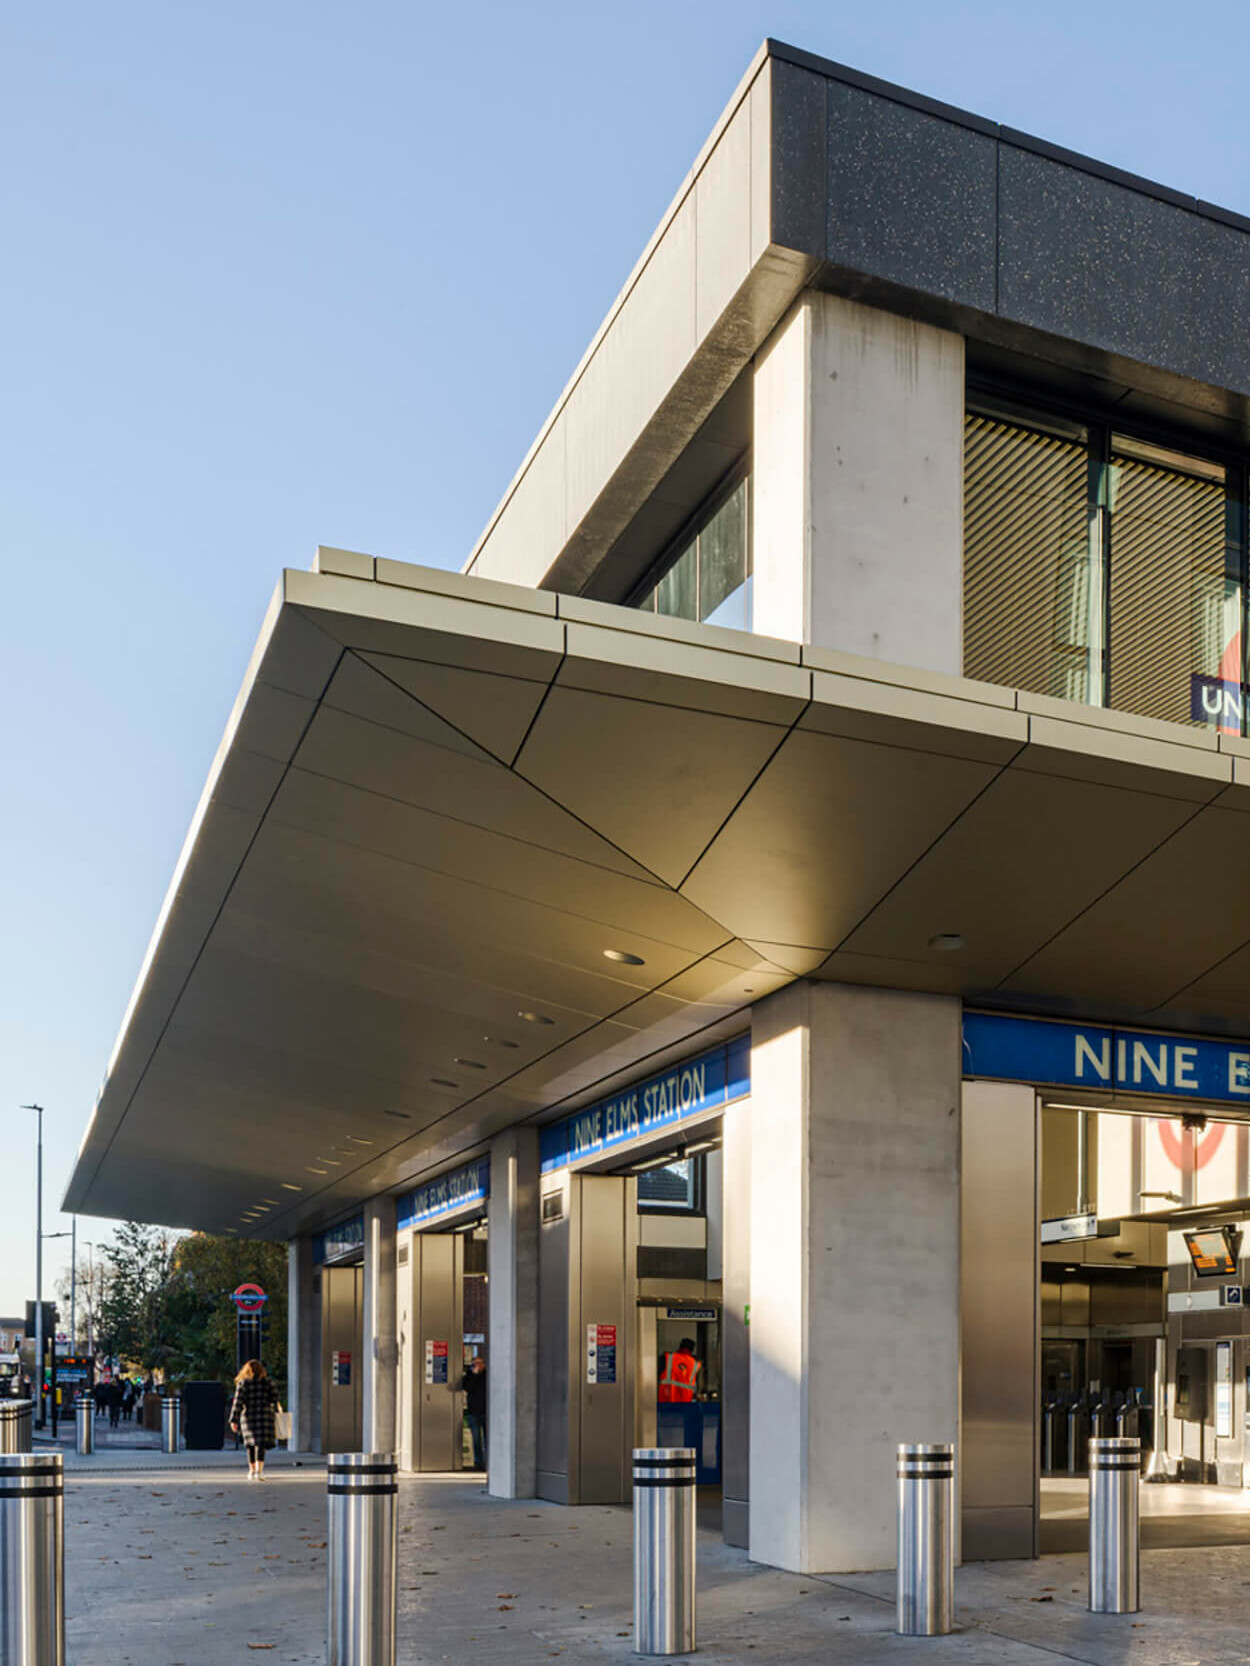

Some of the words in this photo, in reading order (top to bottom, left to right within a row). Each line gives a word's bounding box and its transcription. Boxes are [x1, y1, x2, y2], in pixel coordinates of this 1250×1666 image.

[1075, 1034, 1199, 1088] NINE
[575, 1110, 602, 1154] NINE
[606, 1094, 638, 1141] ELMS
[644, 1063, 705, 1125] STATION
